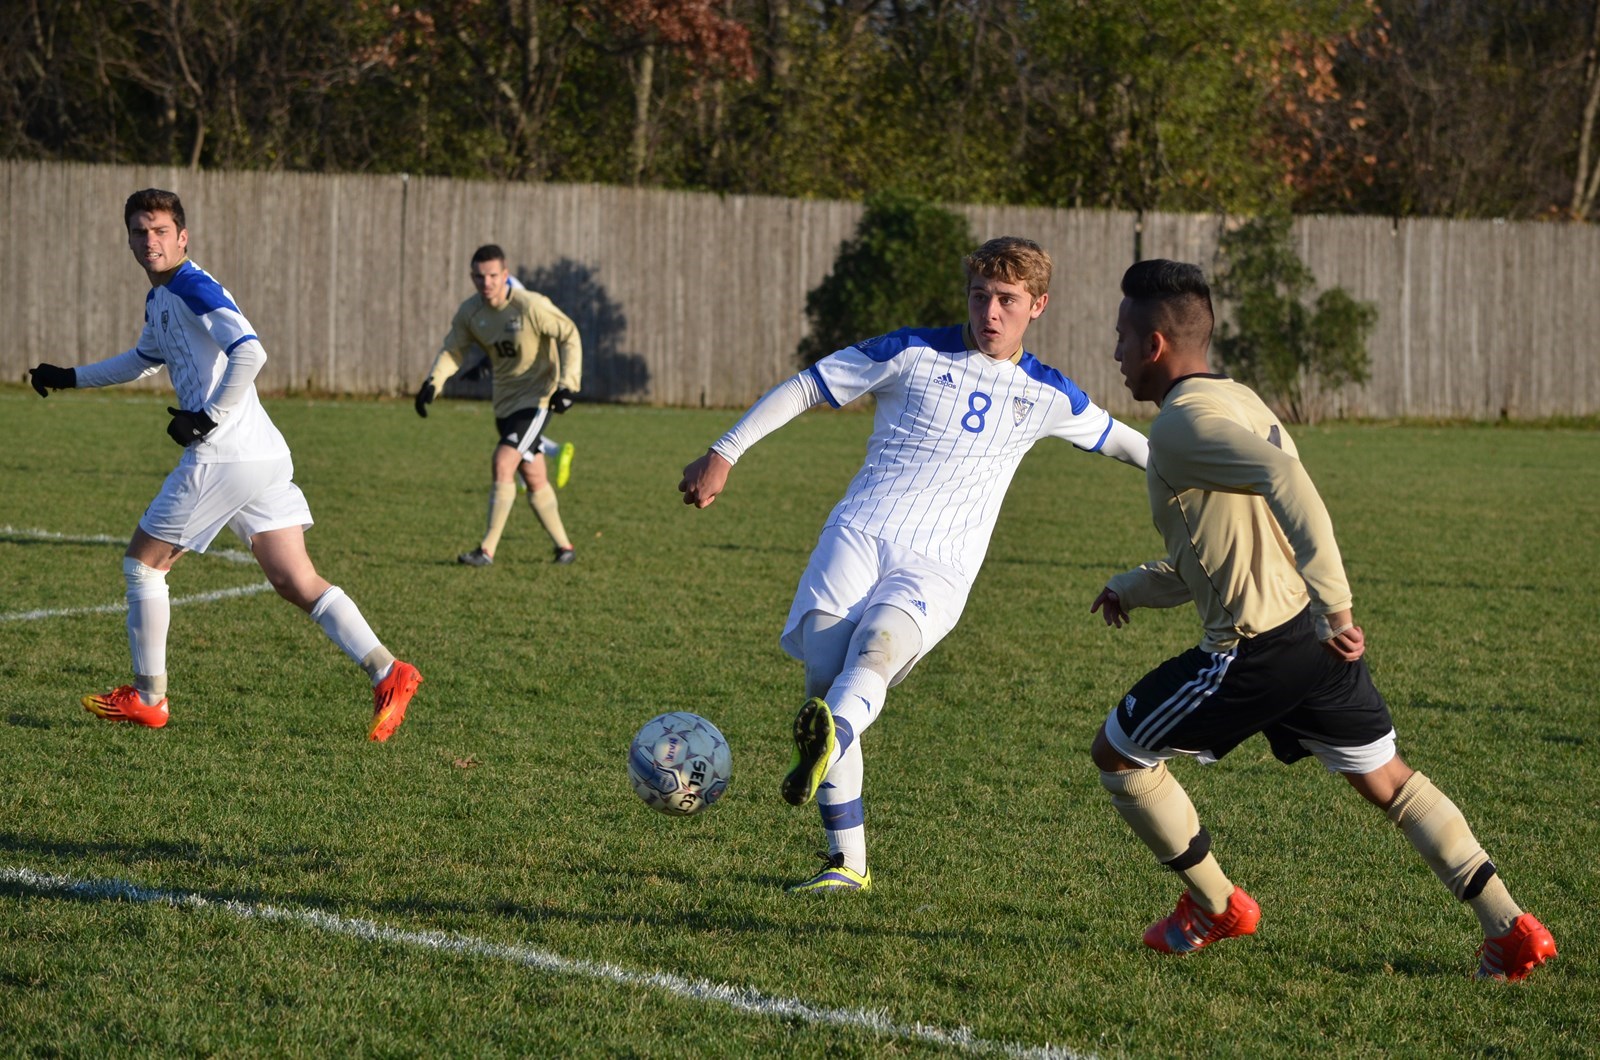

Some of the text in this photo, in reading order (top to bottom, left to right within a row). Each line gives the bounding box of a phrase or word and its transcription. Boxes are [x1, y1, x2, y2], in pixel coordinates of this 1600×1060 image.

[494, 340, 517, 358] 16
[933, 378, 957, 389] adidas
[961, 391, 992, 433] 8
[675, 760, 707, 813] SELECT
